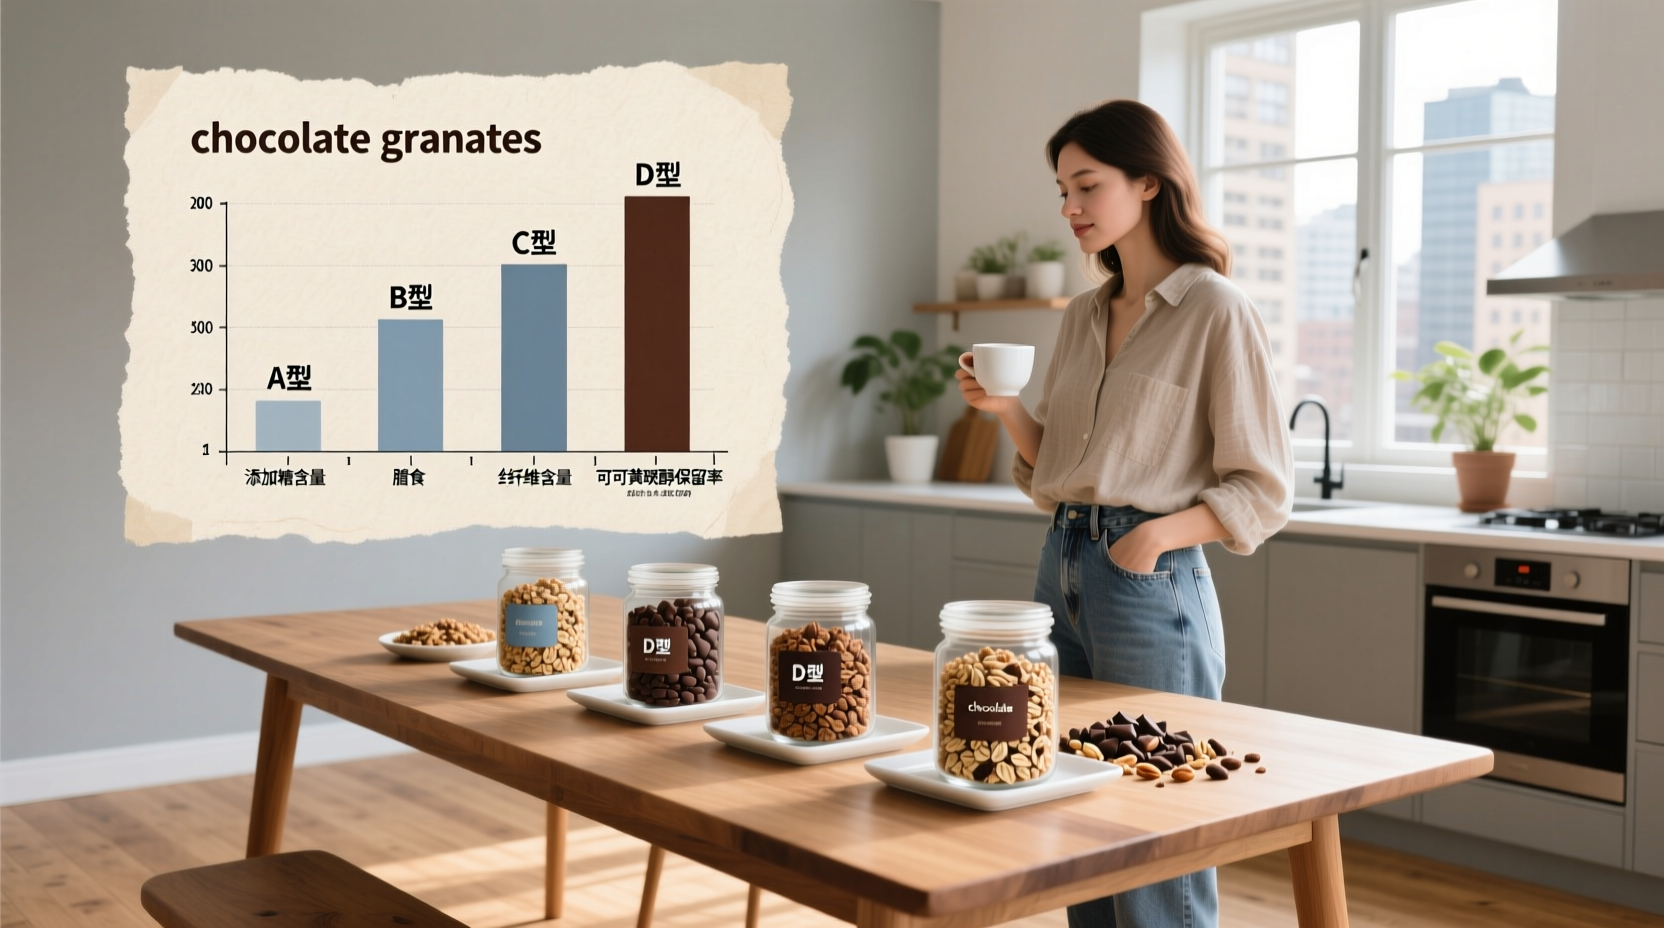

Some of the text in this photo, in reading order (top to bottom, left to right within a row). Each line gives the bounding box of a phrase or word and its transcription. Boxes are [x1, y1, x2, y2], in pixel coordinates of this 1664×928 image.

[191, 120, 542, 164] chocolate granates
[636, 160, 682, 188] D型
[511, 229, 557, 256] C型
[391, 283, 433, 311] B型
[266, 364, 312, 392] A型
